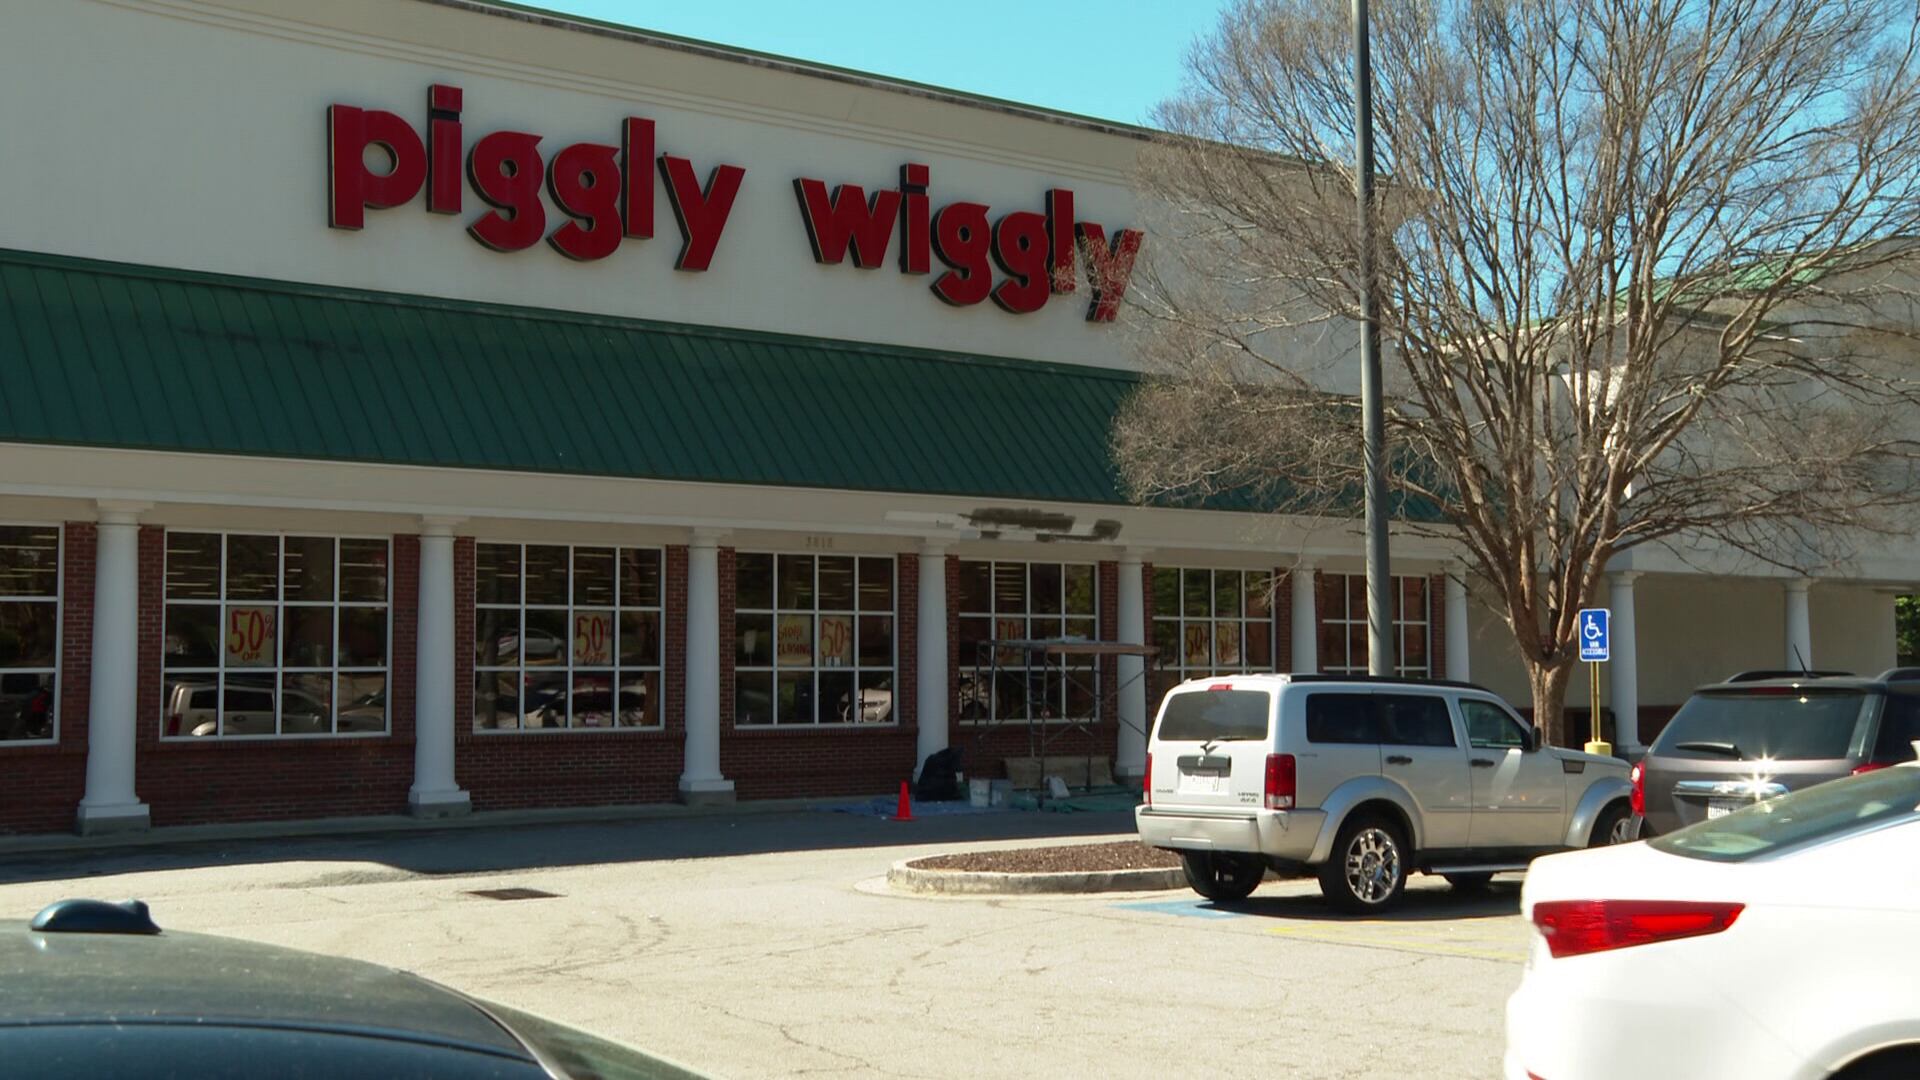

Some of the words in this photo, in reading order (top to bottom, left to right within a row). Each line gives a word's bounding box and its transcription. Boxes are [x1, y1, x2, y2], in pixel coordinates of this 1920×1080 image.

[327, 84, 746, 271] piggly
[792, 163, 1145, 323] wiggly
[229, 609, 273, 653] 50%
